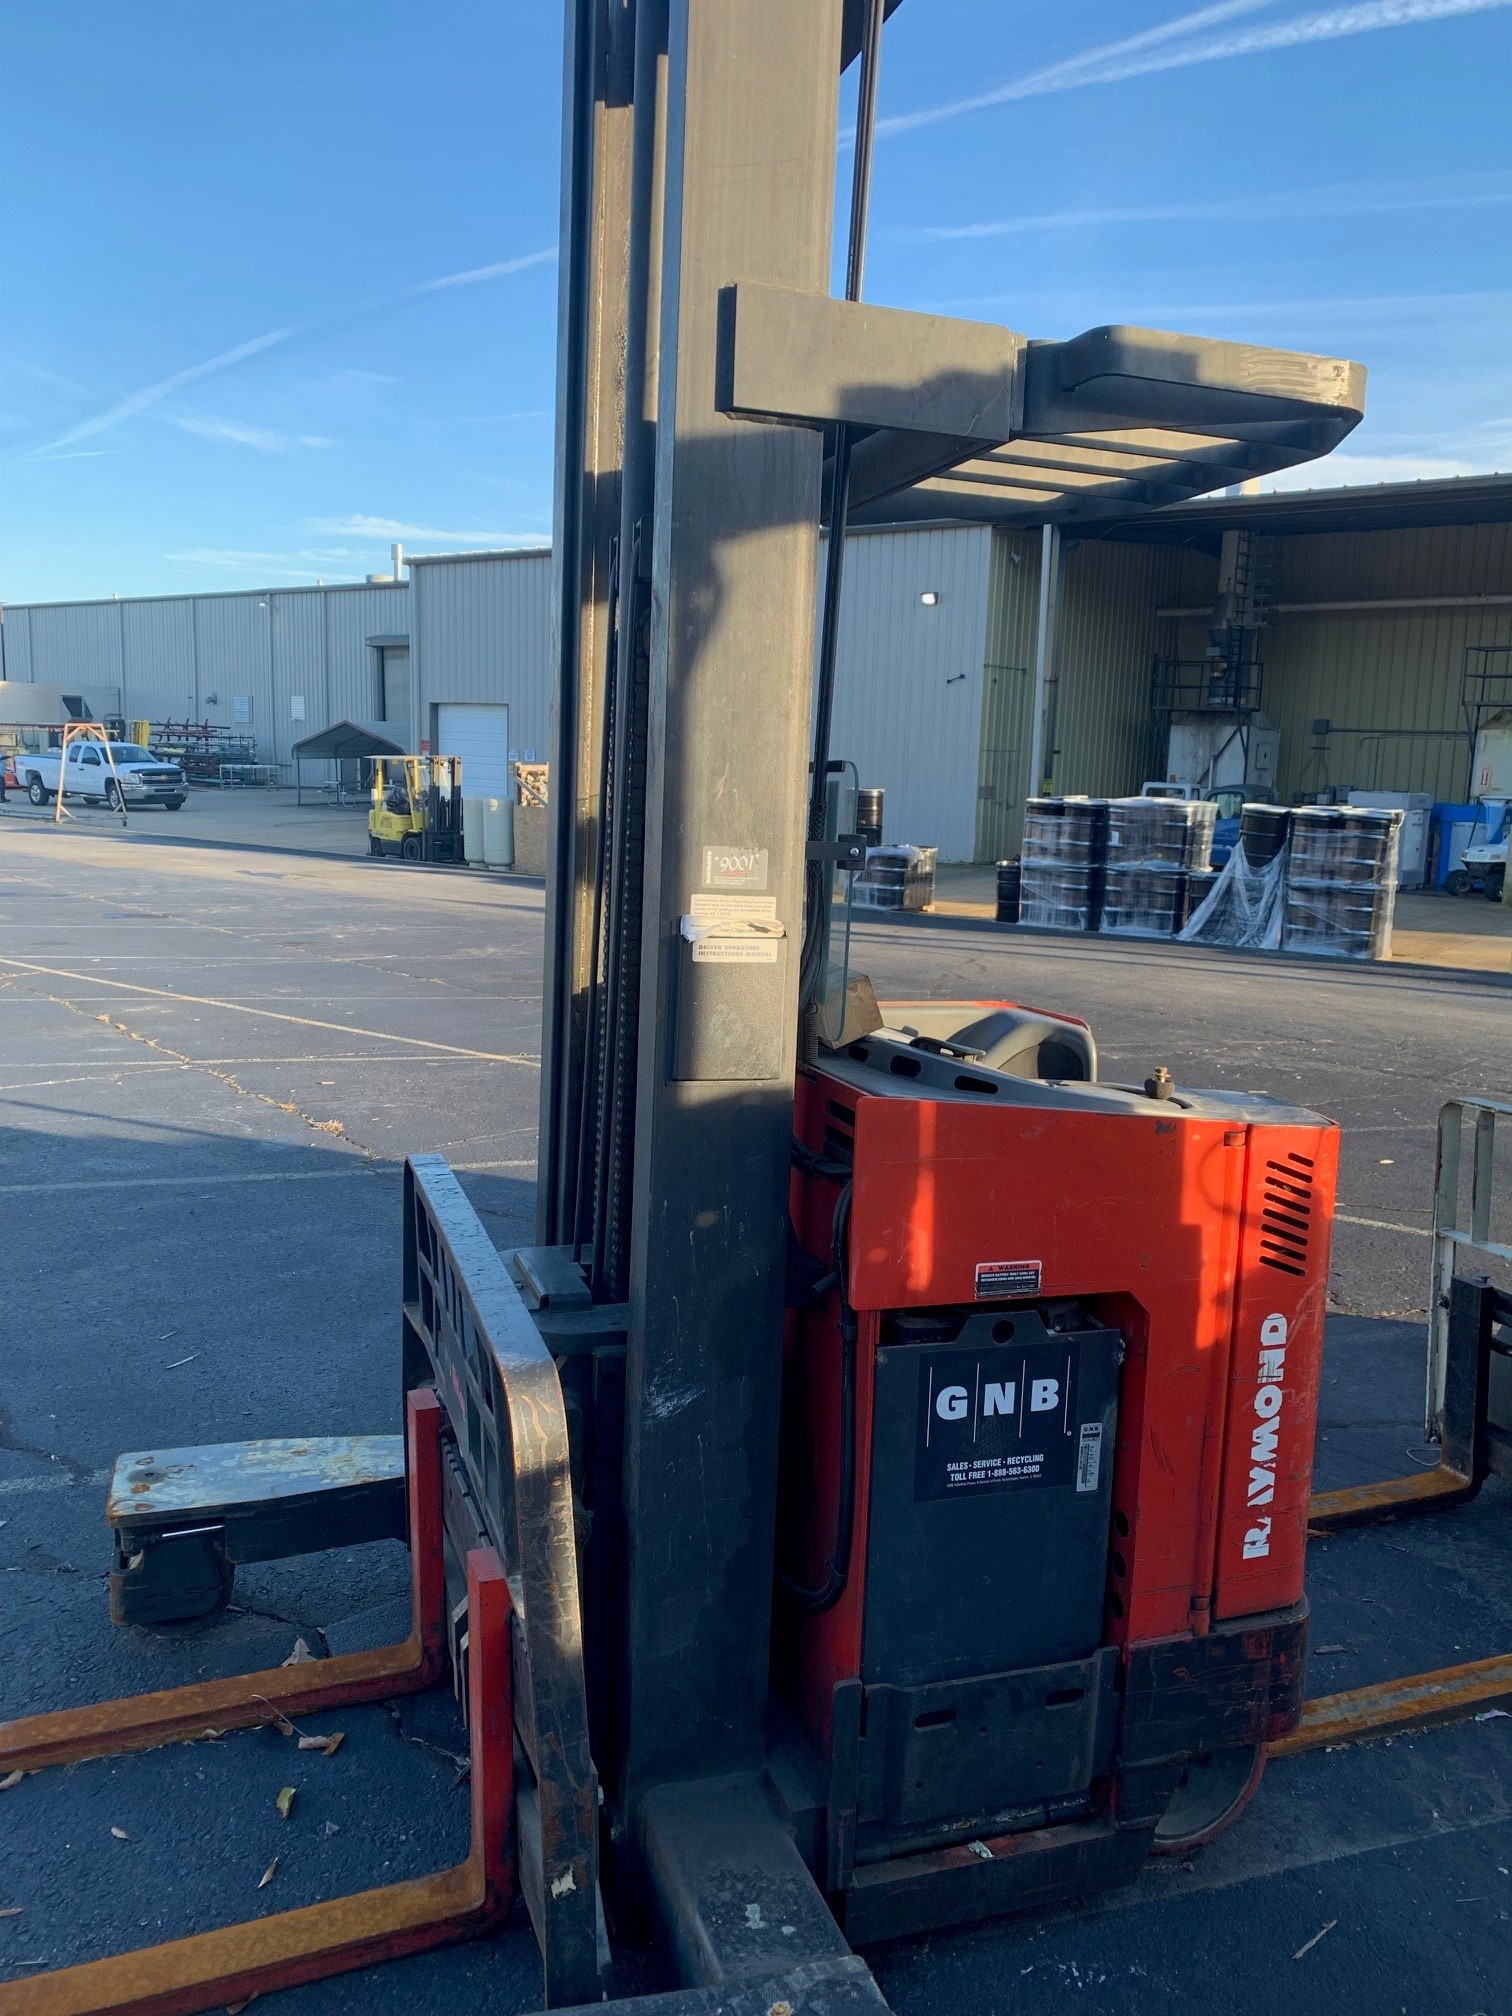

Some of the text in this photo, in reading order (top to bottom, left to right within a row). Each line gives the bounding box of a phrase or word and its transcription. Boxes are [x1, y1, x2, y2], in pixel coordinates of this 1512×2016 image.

[946, 1453, 1044, 1472] SALES SERVICE RECYCLING
[950, 1472, 967, 1482] TOLL
[968, 1470, 986, 1480] FREE
[987, 1464, 1040, 1478] 1-888-563-6300
